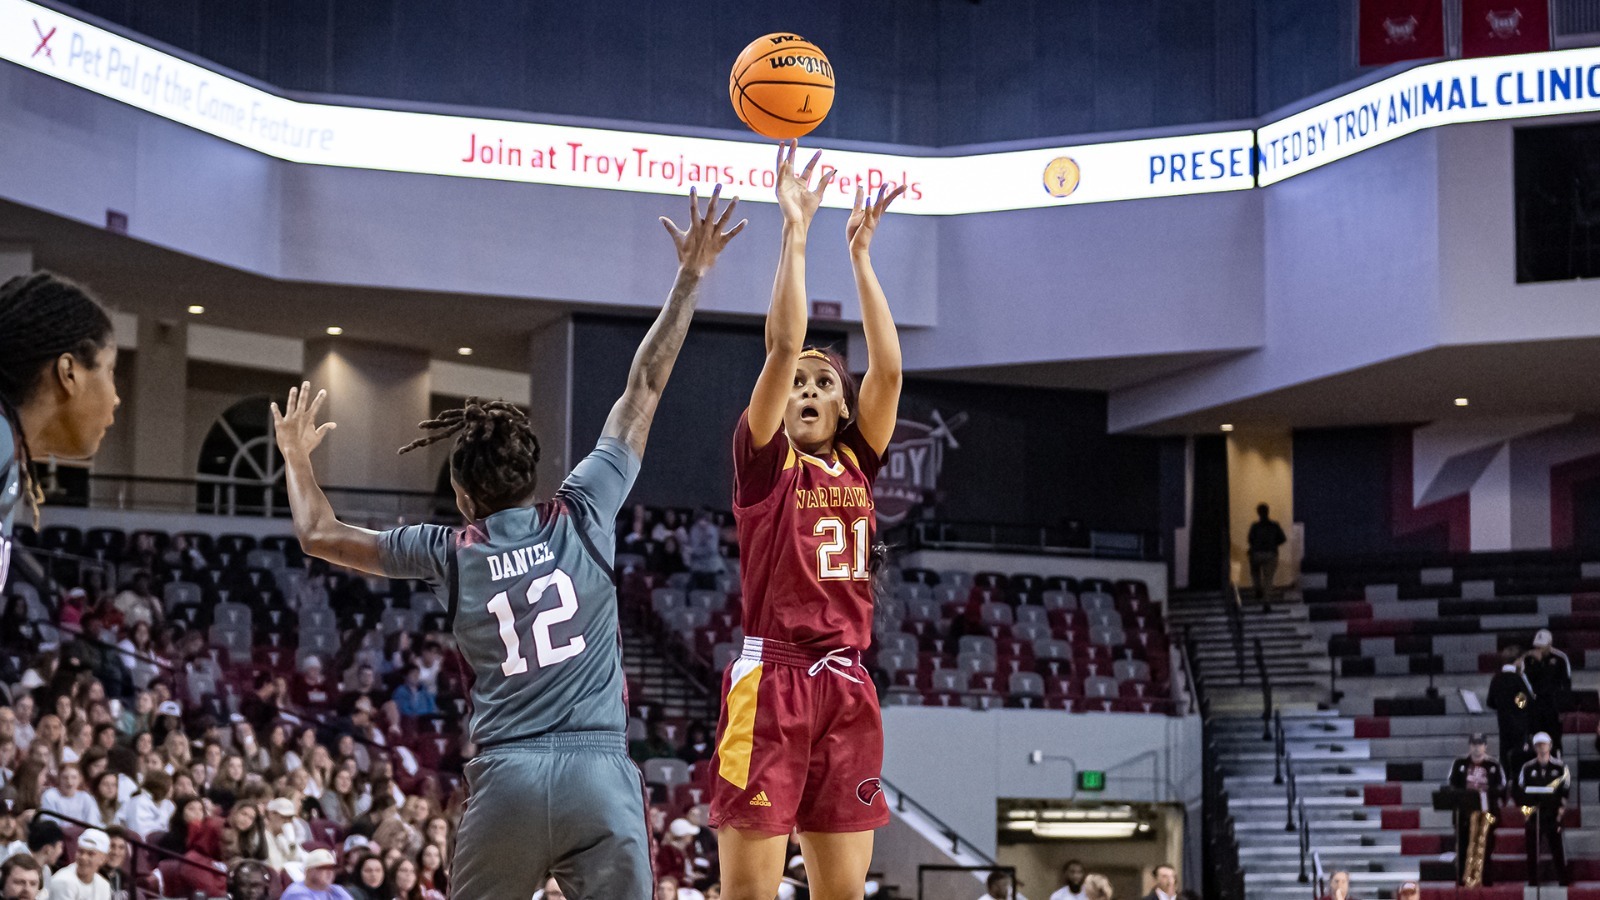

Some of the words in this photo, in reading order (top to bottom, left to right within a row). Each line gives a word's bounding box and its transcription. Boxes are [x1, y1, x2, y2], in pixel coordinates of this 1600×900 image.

[769, 55, 833, 80] Wilson
[69, 32, 102, 77] Pet
[107, 46, 139, 90] Pal
[142, 64, 162, 105] of
[164, 71, 193, 109] the
[196, 80, 246, 130] Game
[249, 101, 334, 150] Feature
[1149, 131, 1302, 184] PRESENTED
[1307, 119, 1328, 157] BY
[1334, 99, 1381, 147] TROY
[1387, 75, 1489, 127] ANIMAL
[1496, 64, 1600, 106] CLINIC
[462, 133, 521, 167] Join
[531, 146, 557, 170] at
[880, 446, 928, 486] OY
[796, 486, 874, 510] WARHAW
[487, 541, 555, 581] DANIEL
[813, 517, 870, 581] 21
[487, 568, 586, 677] 12
